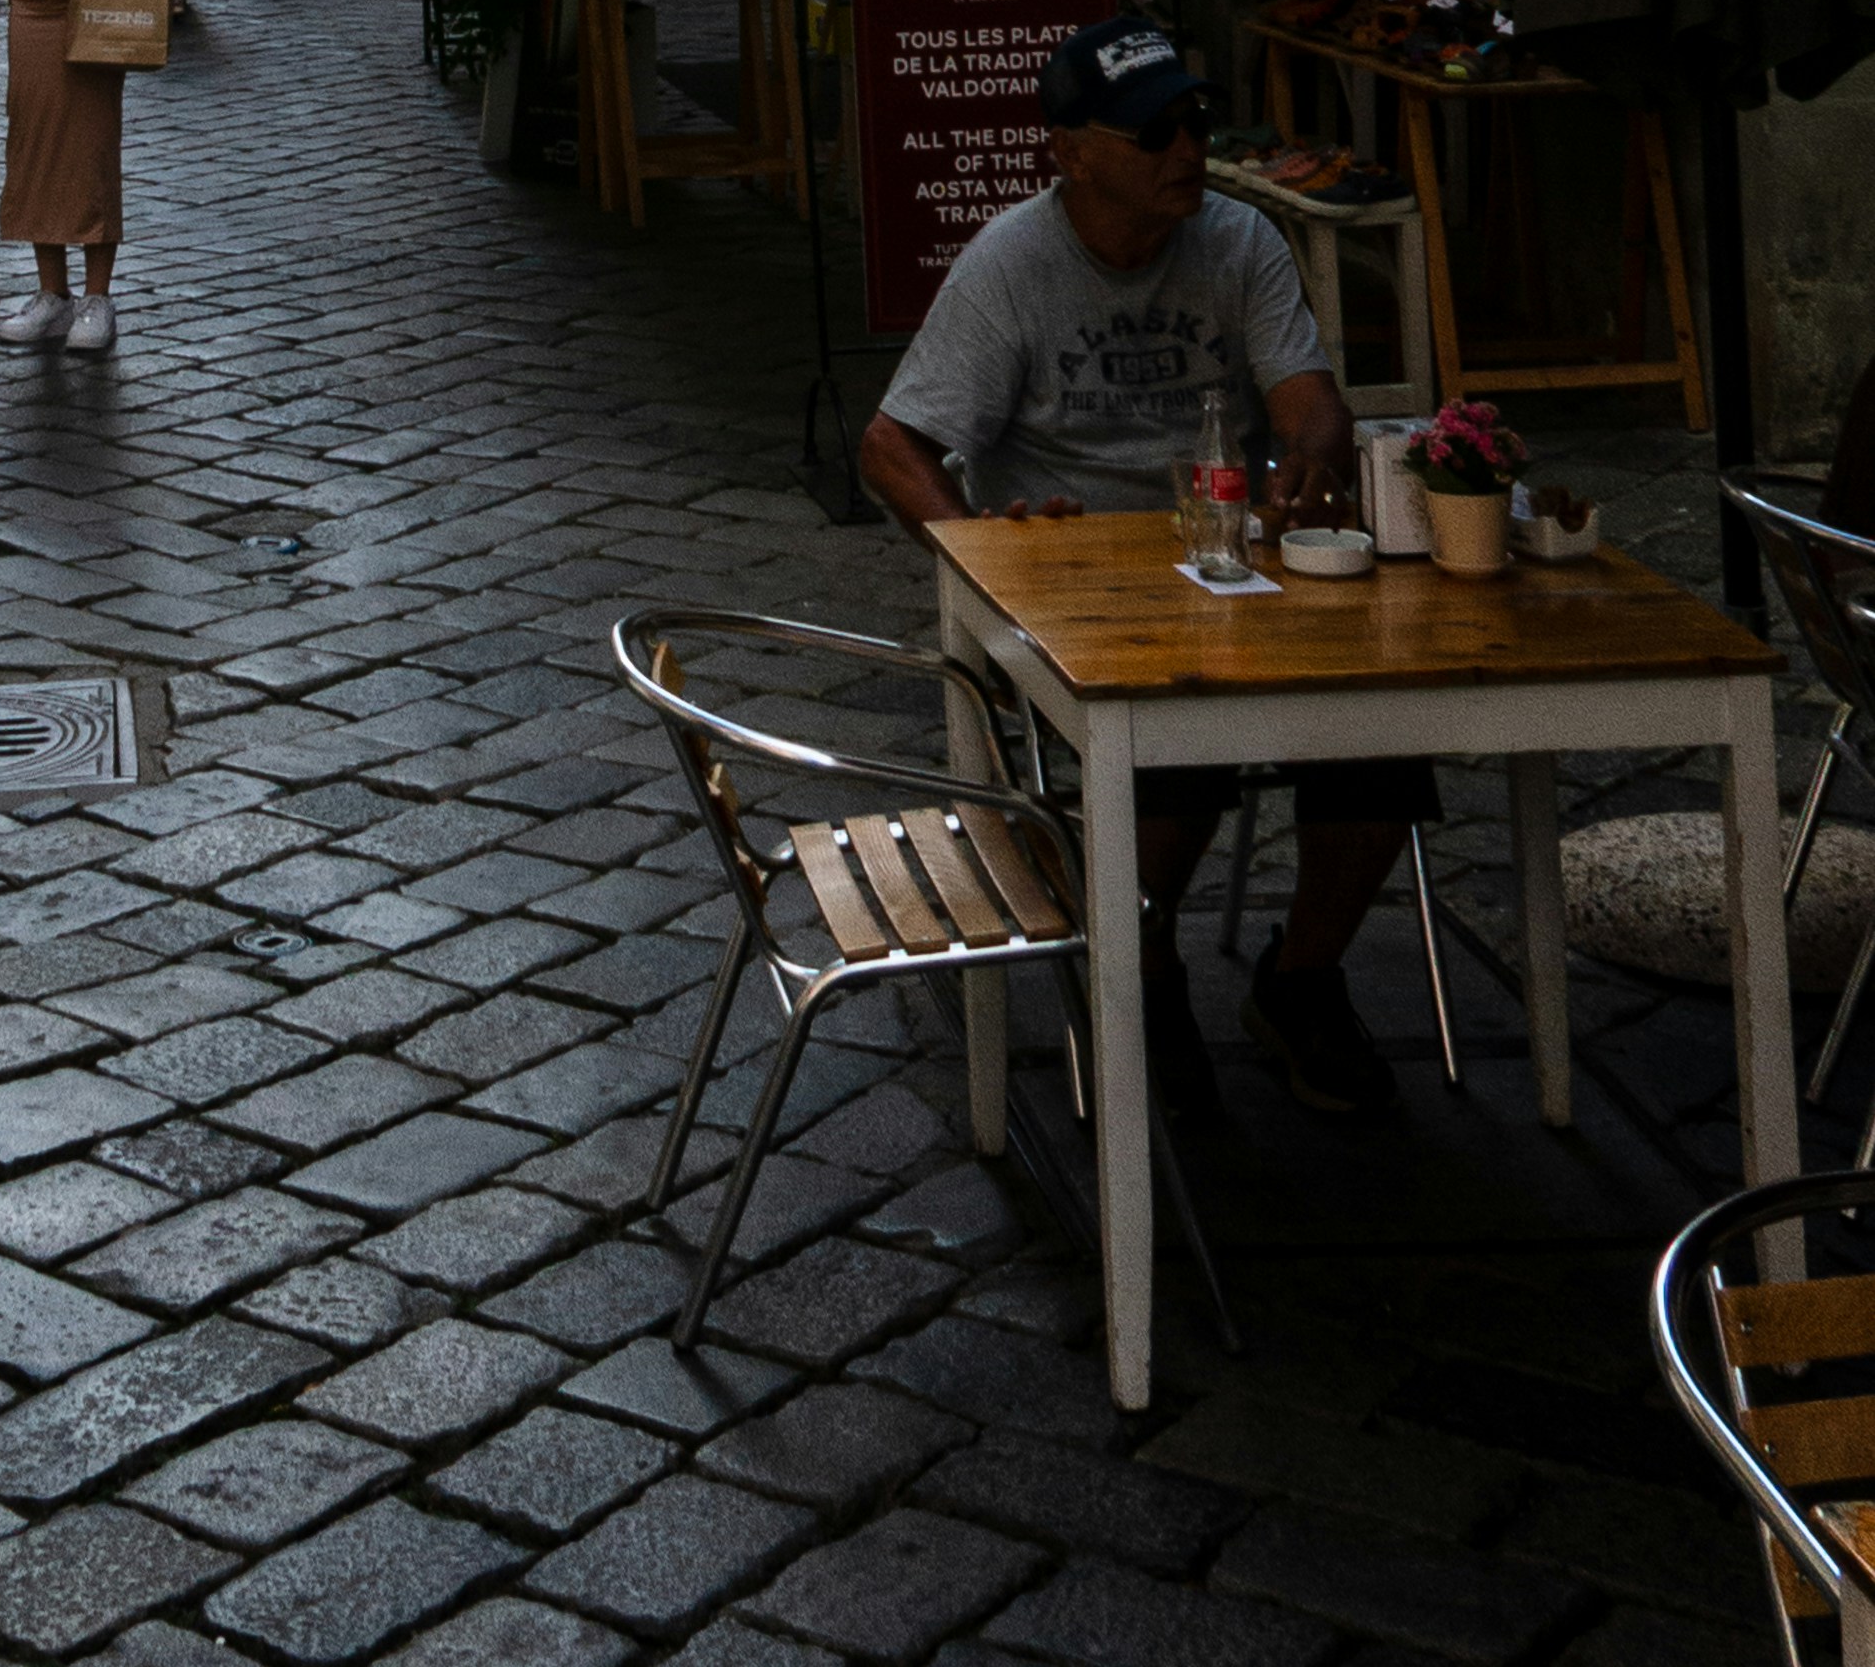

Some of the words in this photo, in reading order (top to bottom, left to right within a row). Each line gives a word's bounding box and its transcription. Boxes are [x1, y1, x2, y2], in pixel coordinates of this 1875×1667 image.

[895, 29, 958, 50] TOUS
[964, 26, 1006, 47] LES
[893, 55, 924, 76] DE
[927, 54, 957, 75] LA
[902, 131, 946, 151] ALL
[950, 128, 995, 149] THE
[954, 154, 984, 174] OF
[990, 151, 1036, 173] THE
[914, 178, 990, 201] AOSTA
[934, 202, 1017, 225] TRADI
[1108, 352, 1179, 383] 1959
[1060, 390, 1098, 412] THE
